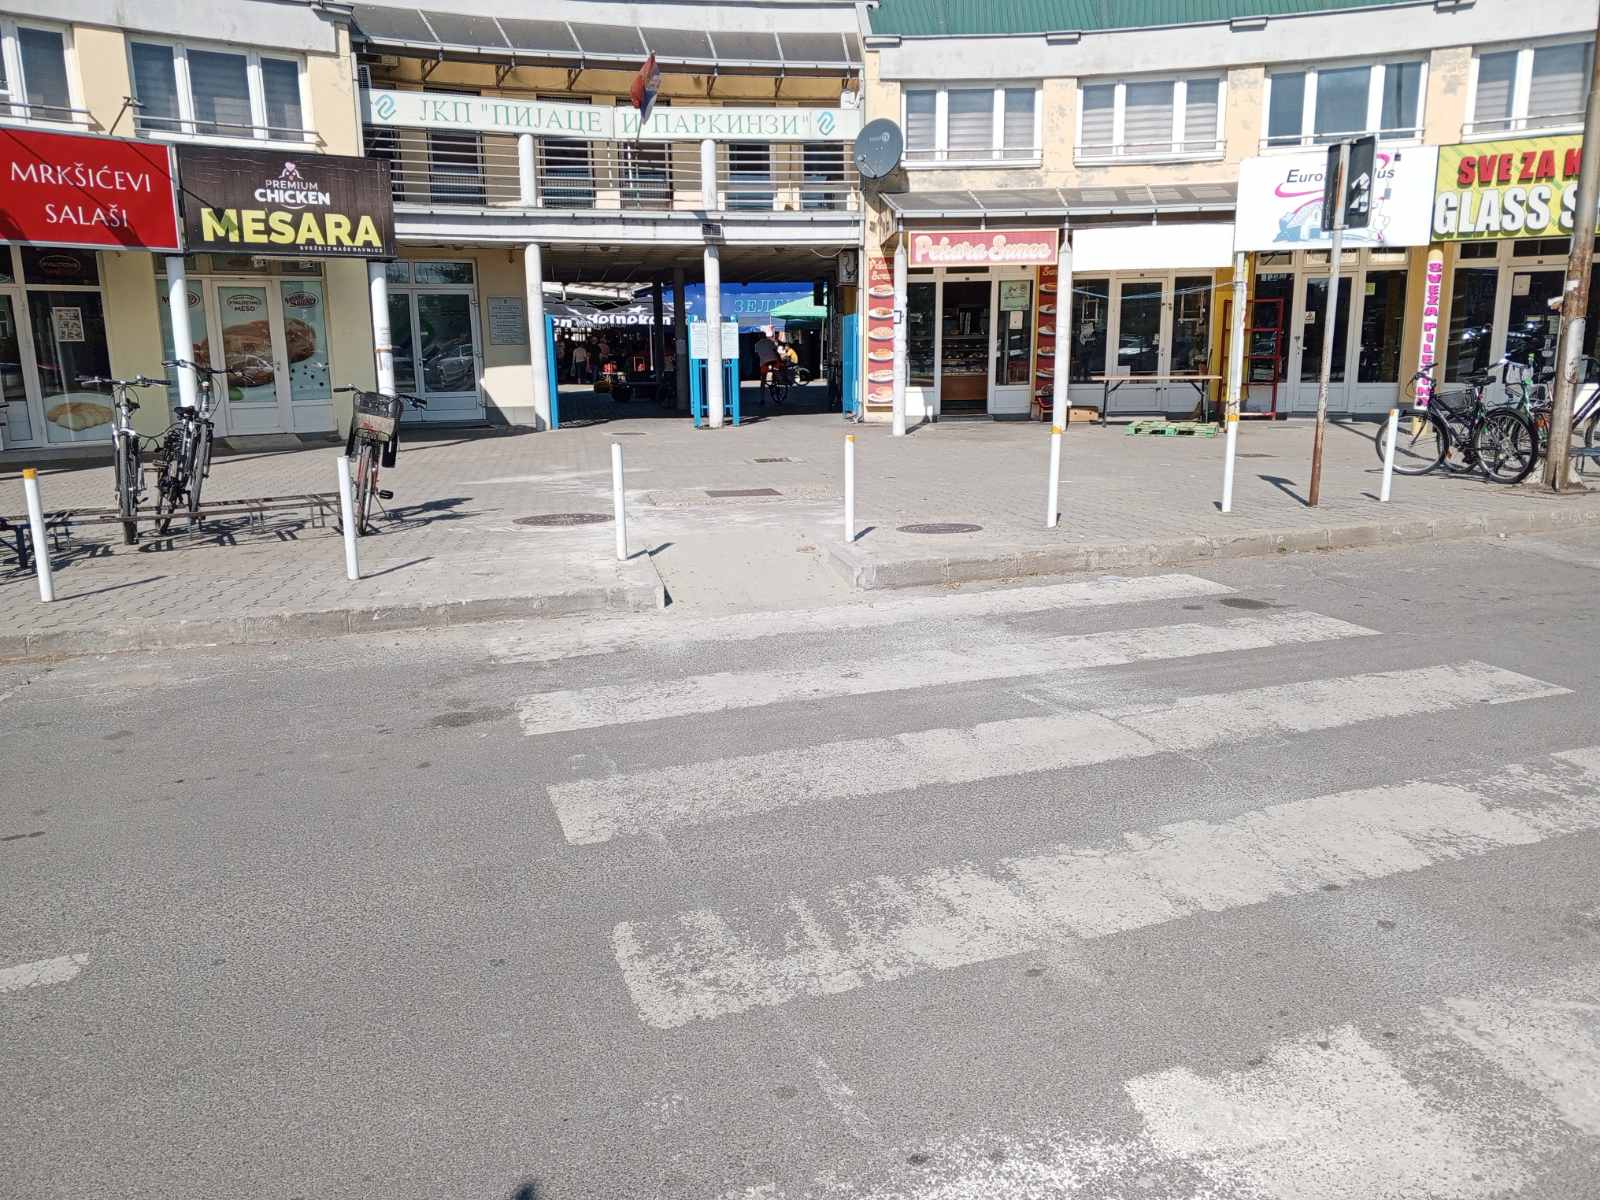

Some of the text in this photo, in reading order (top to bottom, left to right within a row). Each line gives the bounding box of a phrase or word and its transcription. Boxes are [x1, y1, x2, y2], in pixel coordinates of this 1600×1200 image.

[419, 99, 472, 123] ЈКП
[481, 103, 602, 134] "ПИЈАЦЕ
[654, 112, 809, 135] ПАРКИНЗИ"
[10, 161, 152, 192] MRKŠIĆEVI
[265, 179, 319, 190] PREMIUM
[1457, 153, 1514, 187] SVE
[1518, 150, 1556, 182] ZA
[254, 188, 331, 206] CHICKEN
[1433, 185, 1552, 238] GLASS
[45, 203, 129, 228] SALAŠI
[200, 207, 382, 248] MESARA
